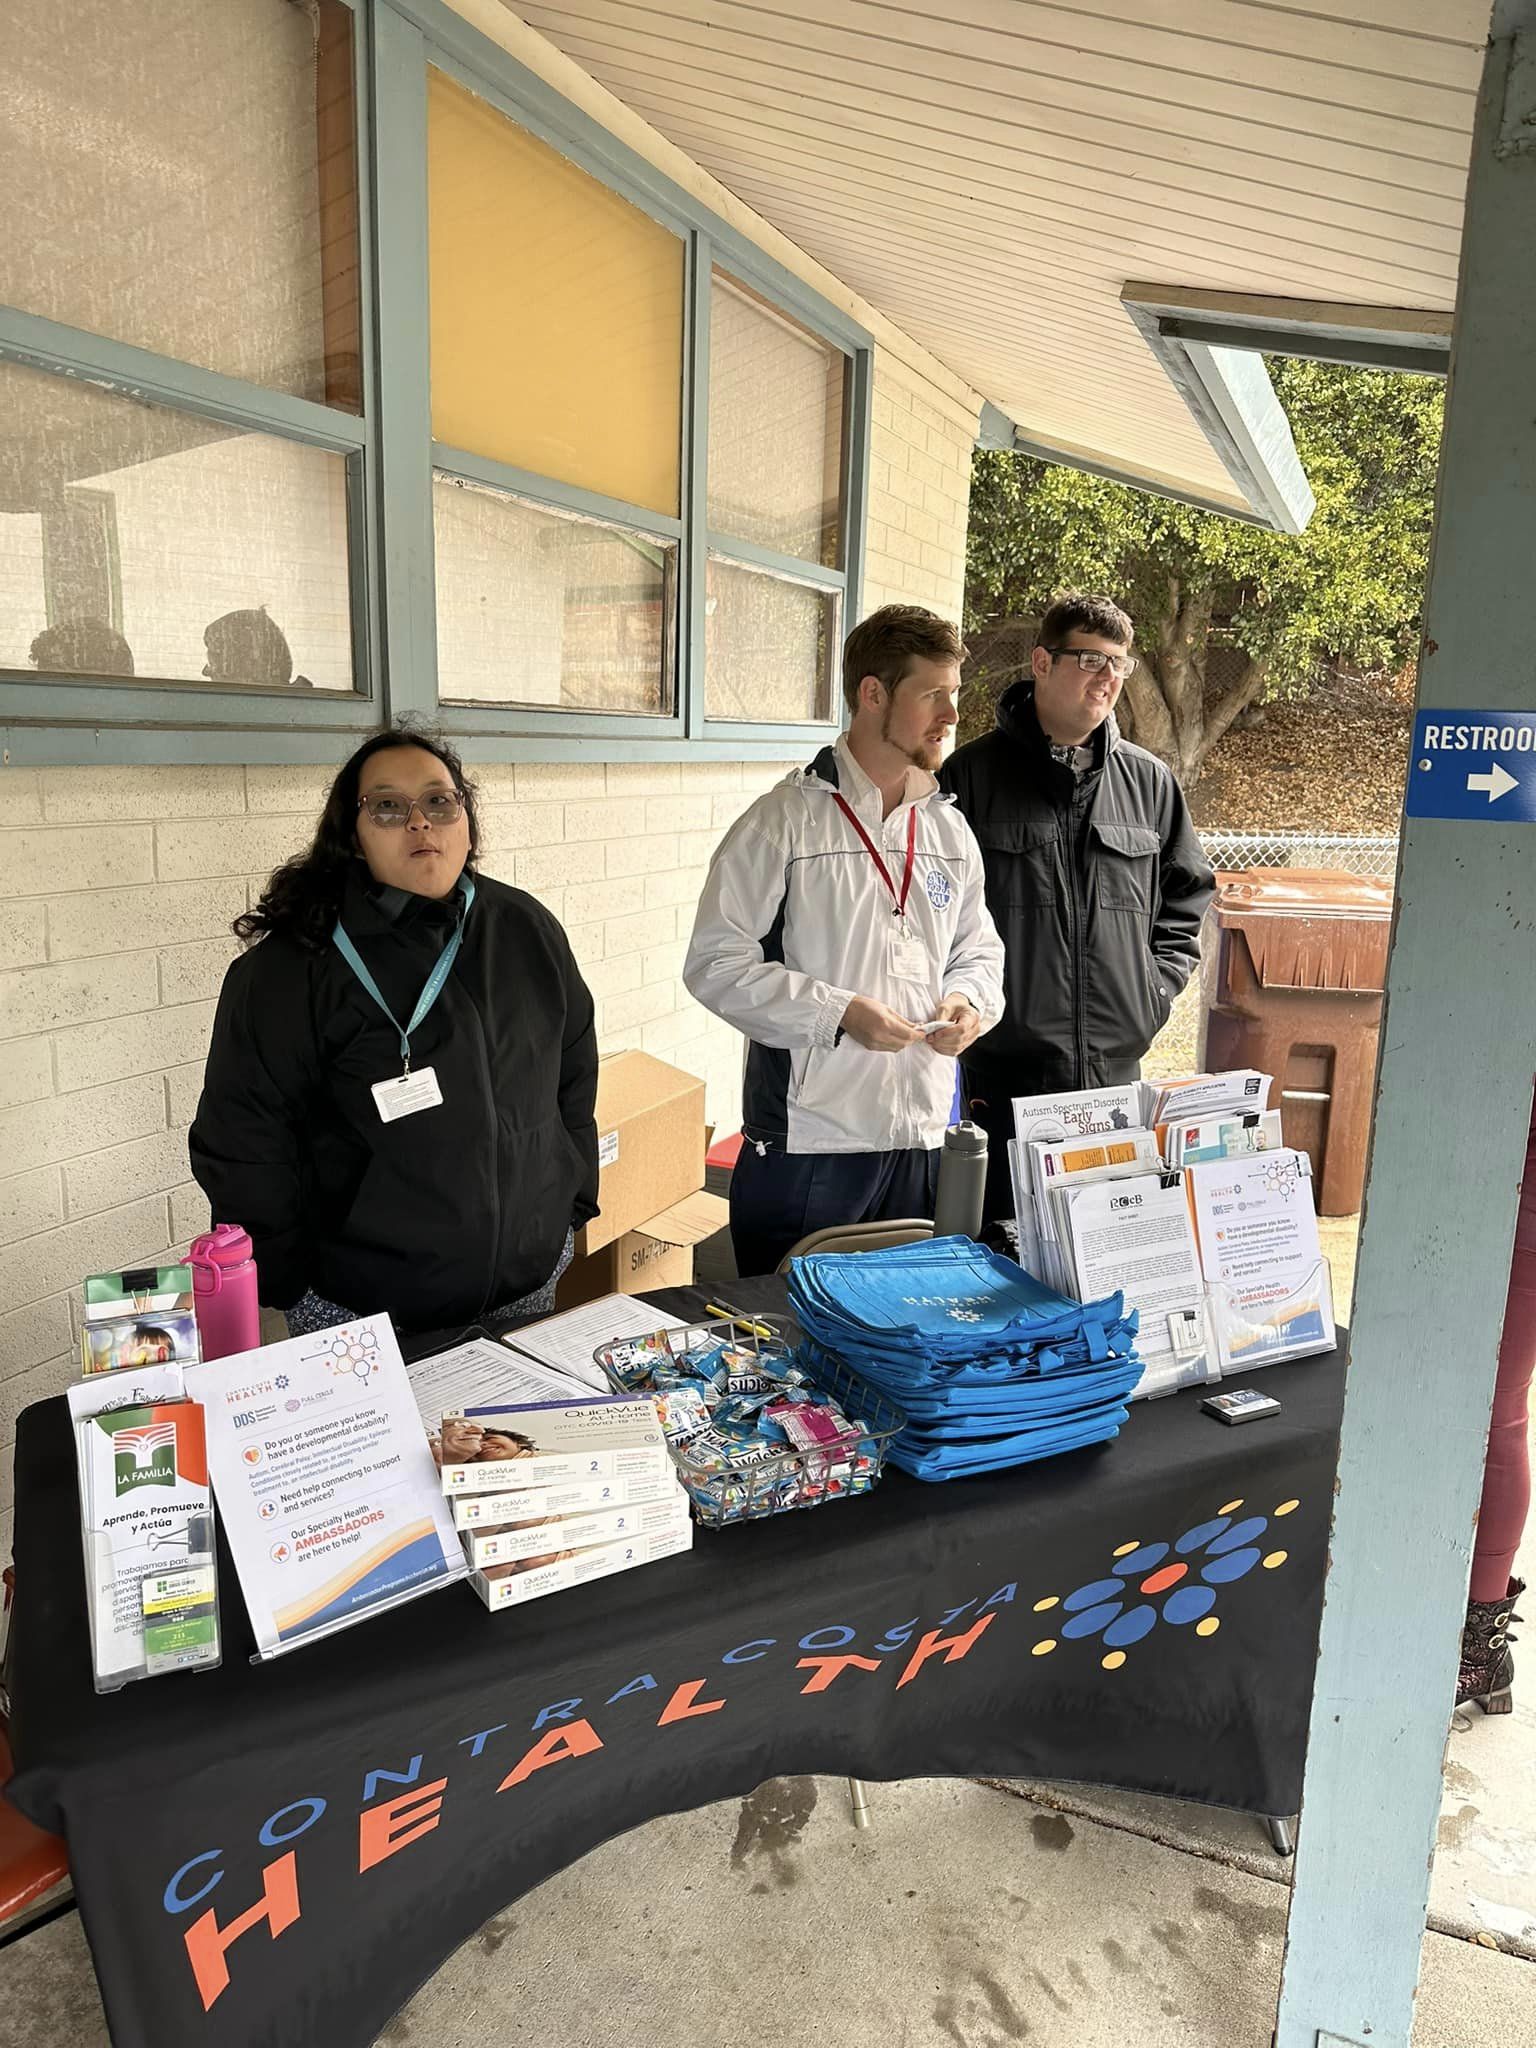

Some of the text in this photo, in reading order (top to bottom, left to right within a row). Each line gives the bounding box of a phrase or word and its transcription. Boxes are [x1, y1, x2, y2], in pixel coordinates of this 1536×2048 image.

[1424, 725, 1536, 752] RESTROO
[1022, 1097, 1129, 1118] Autism Spectrum Disorder
[1063, 1111, 1093, 1124] Early
[1078, 1121, 1111, 1134] Signs
[227, 1385, 273, 1405] HEALTH
[233, 1411, 256, 1429] DDS
[564, 1405, 649, 1418] QuickVue
[264, 1408, 375, 1450] Do you or someone you know
[267, 1449, 287, 1460] have
[295, 1425, 352, 1451] developmental
[352, 1412, 388, 1432] disability?
[477, 1466, 517, 1477] QuickVue
[590, 1460, 598, 1471] 2
[118, 1466, 173, 1485] LA FAMILIA
[279, 1454, 400, 1502] Need help connecting to support
[283, 1487, 334, 1513] and services?
[602, 1487, 610, 1498] 2
[491, 1497, 530, 1509] QuickVue
[102, 1501, 205, 1527] Aprende, Promueve
[290, 1504, 369, 1539] Our Specialty Health
[617, 1517, 625, 1528] 2
[131, 1517, 172, 1535] y Actúa
[295, 1510, 385, 1551] AMBASSADORS
[298, 1532, 361, 1562] are here to help!
[509, 1531, 548, 1546] QuickVue
[625, 1549, 633, 1560] 2
[117, 1559, 168, 1577] Trabajamos
[101, 1573, 141, 1593] promover
[523, 1570, 560, 1586] QuickVue
[112, 1591, 142, 1607] dispon
[112, 1602, 143, 1617] person
[114, 1620, 144, 1634] discap
[163, 1581, 1019, 1914] CONTRA COSTA
[184, 1611, 997, 2014] HEALTH
